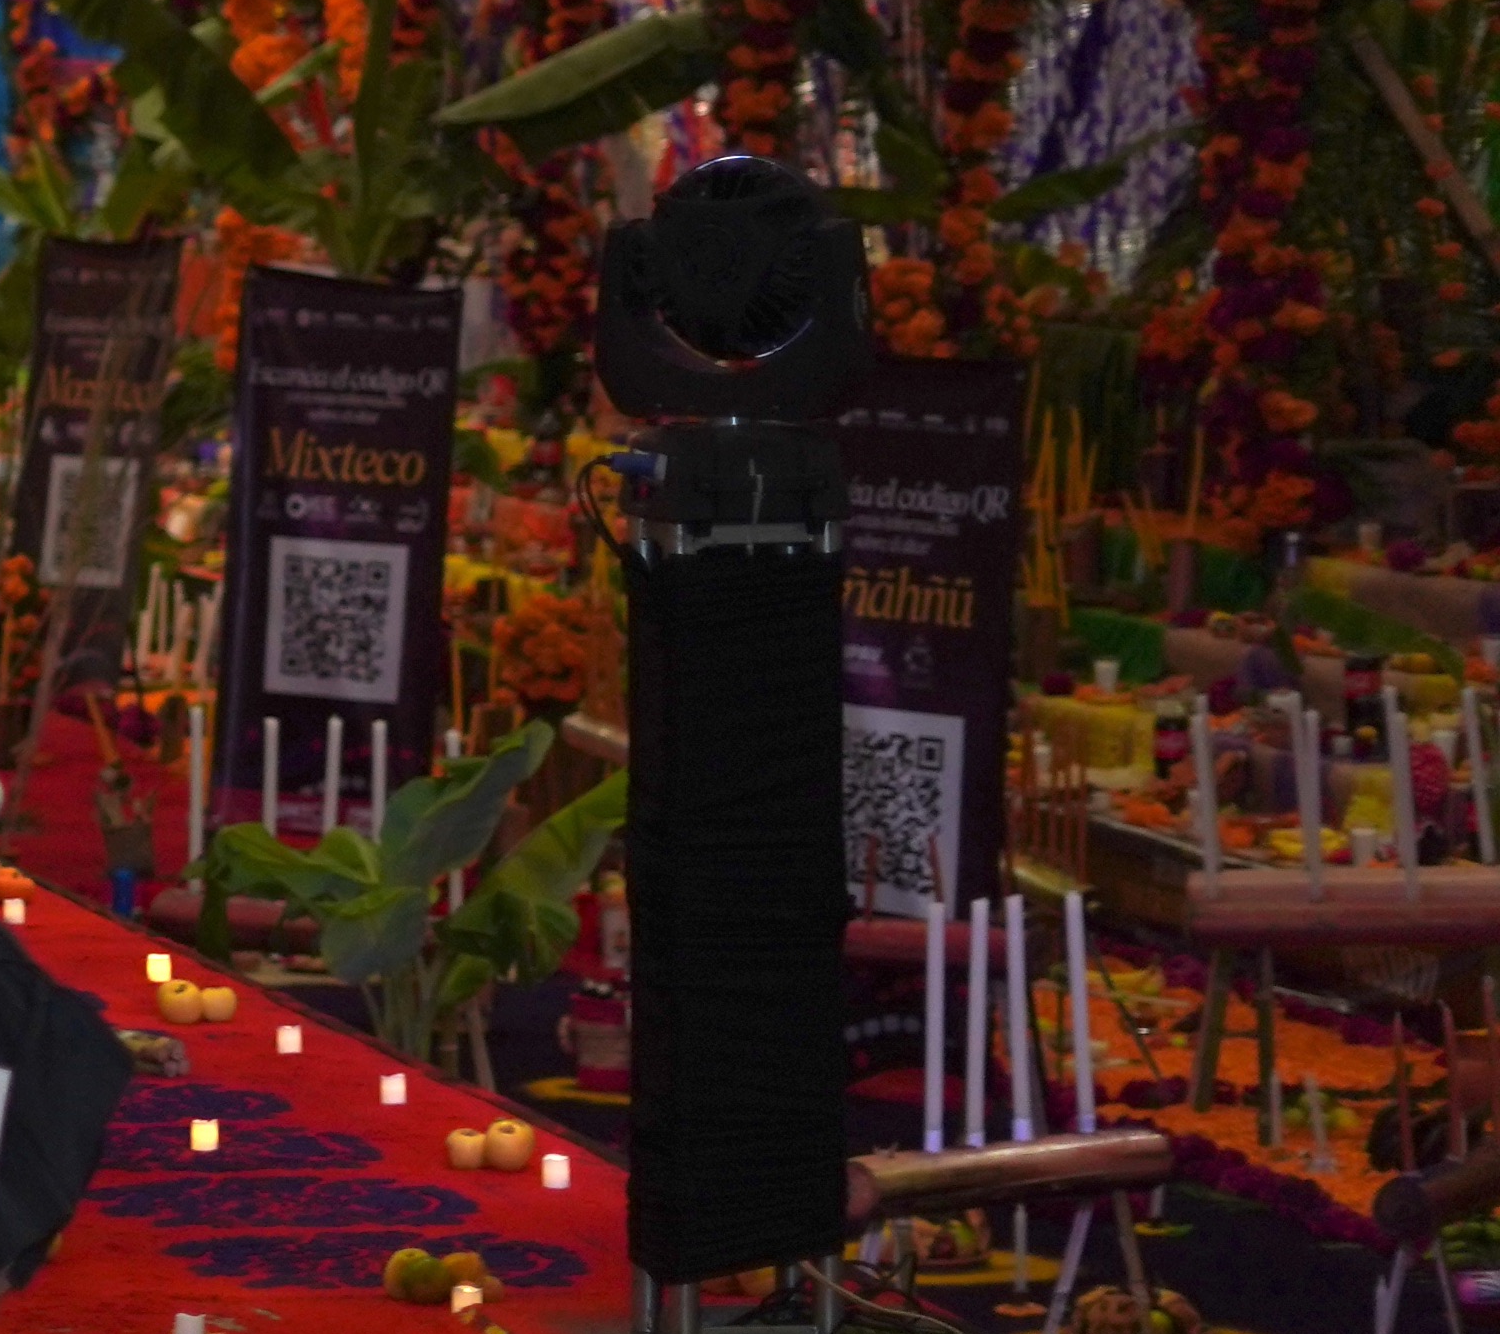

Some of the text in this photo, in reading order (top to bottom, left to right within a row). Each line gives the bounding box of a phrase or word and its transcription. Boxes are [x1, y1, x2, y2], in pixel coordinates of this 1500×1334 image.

[267, 426, 427, 487] Mixteco
[971, 484, 1010, 524] QR
[842, 565, 974, 629] ñähñü
